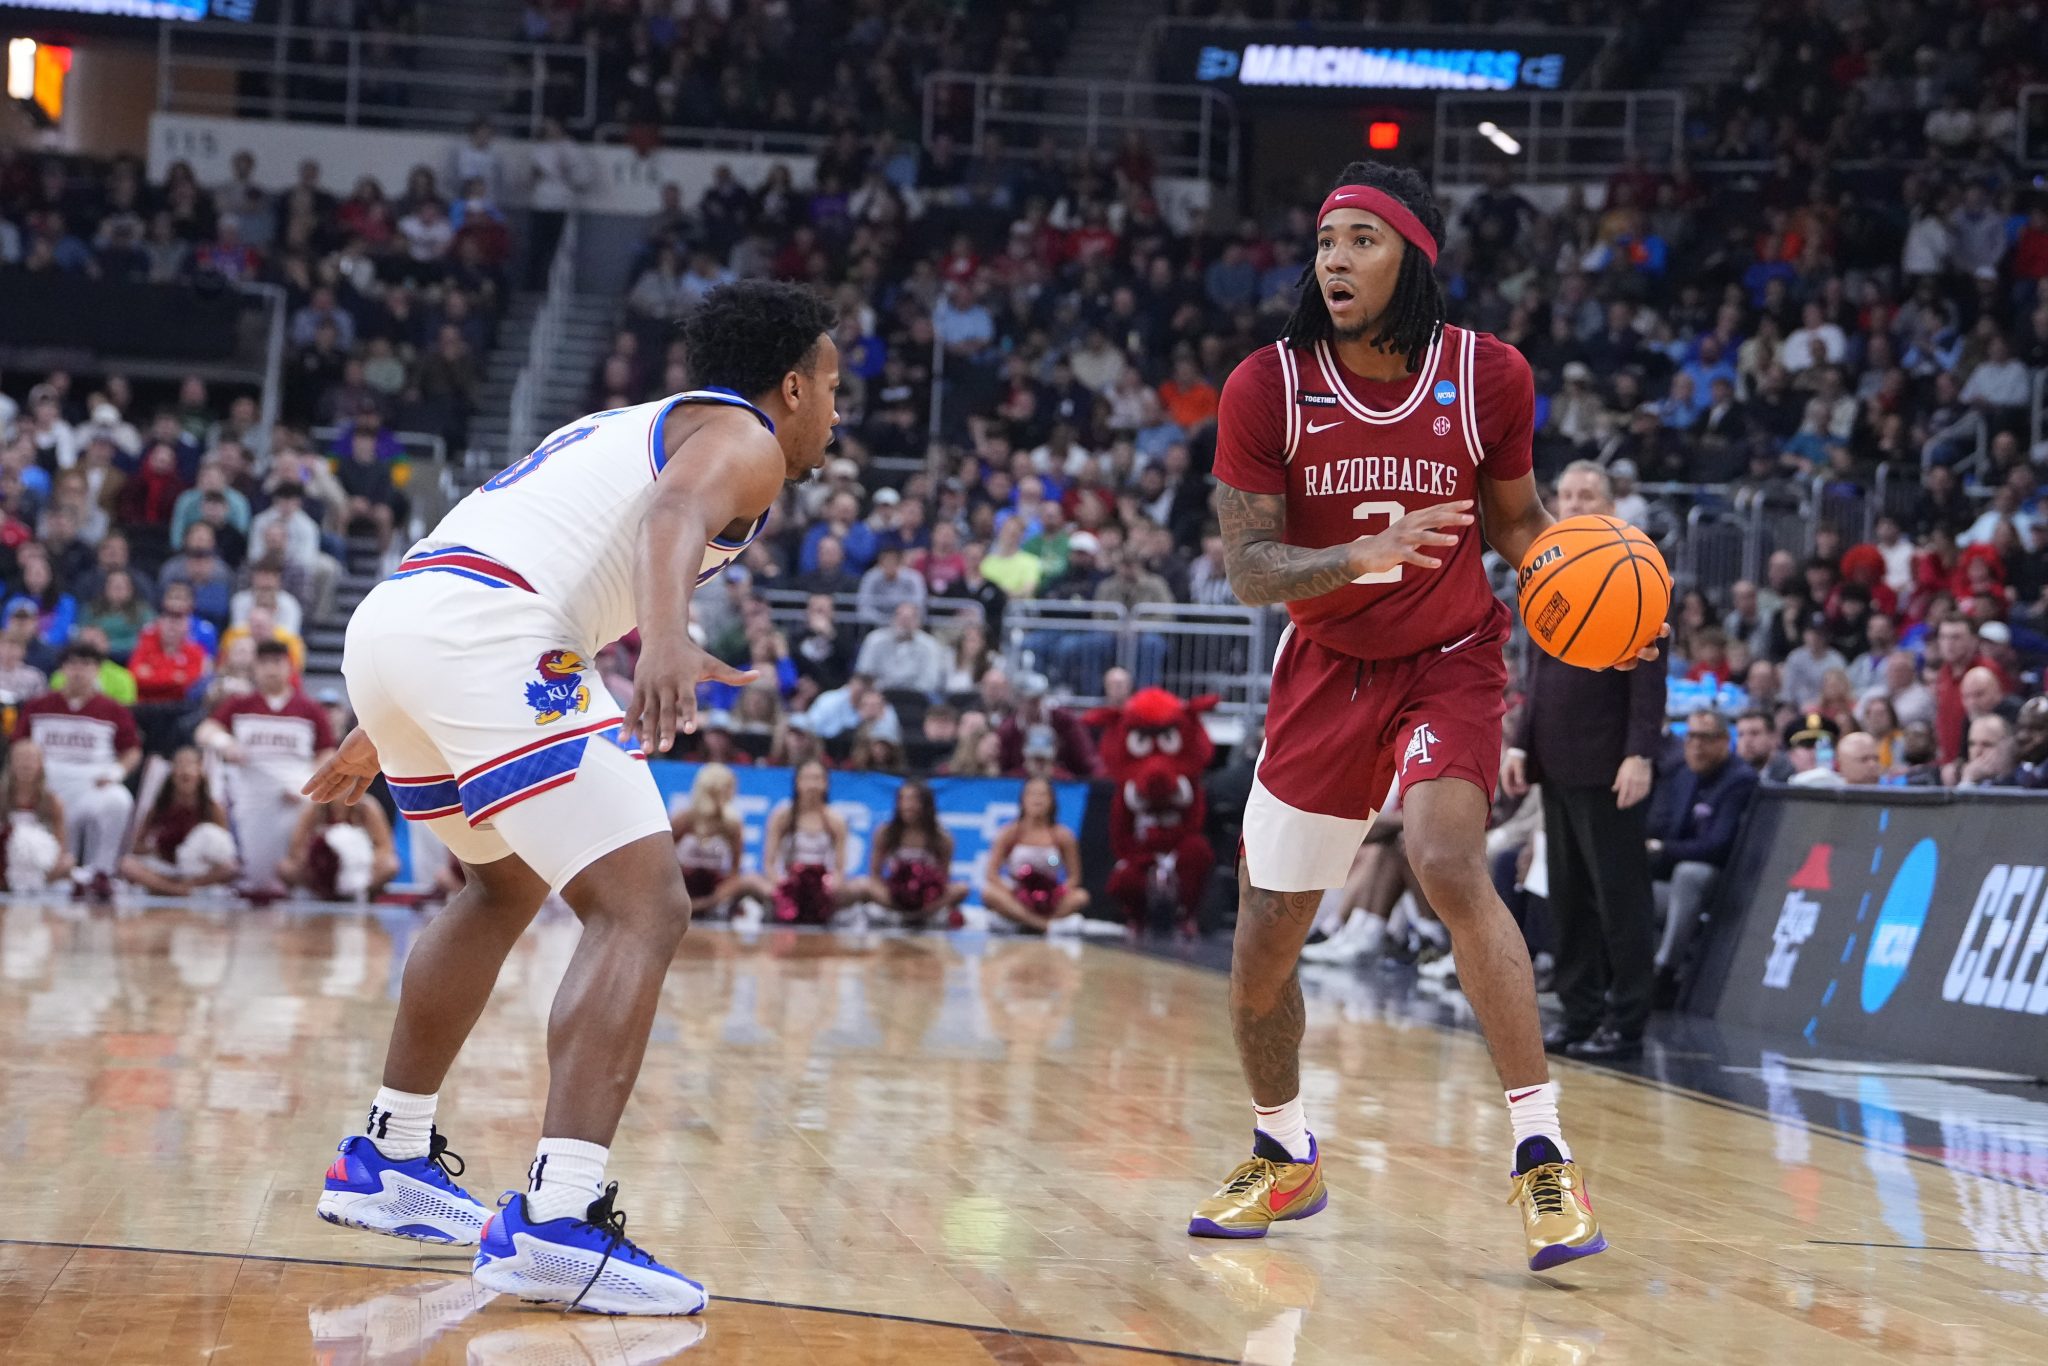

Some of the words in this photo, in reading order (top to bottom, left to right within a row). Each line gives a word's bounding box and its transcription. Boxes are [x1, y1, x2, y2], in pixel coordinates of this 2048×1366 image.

[1304, 395, 1337, 404] TOGETHER
[1437, 391, 1456, 400] NCAA
[1433, 417, 1450, 435] SEC
[1304, 456, 1458, 496] RAZORBACKS
[1351, 501, 1405, 584] 2
[1517, 545, 1562, 597] lson
[546, 684, 569, 701] KU
